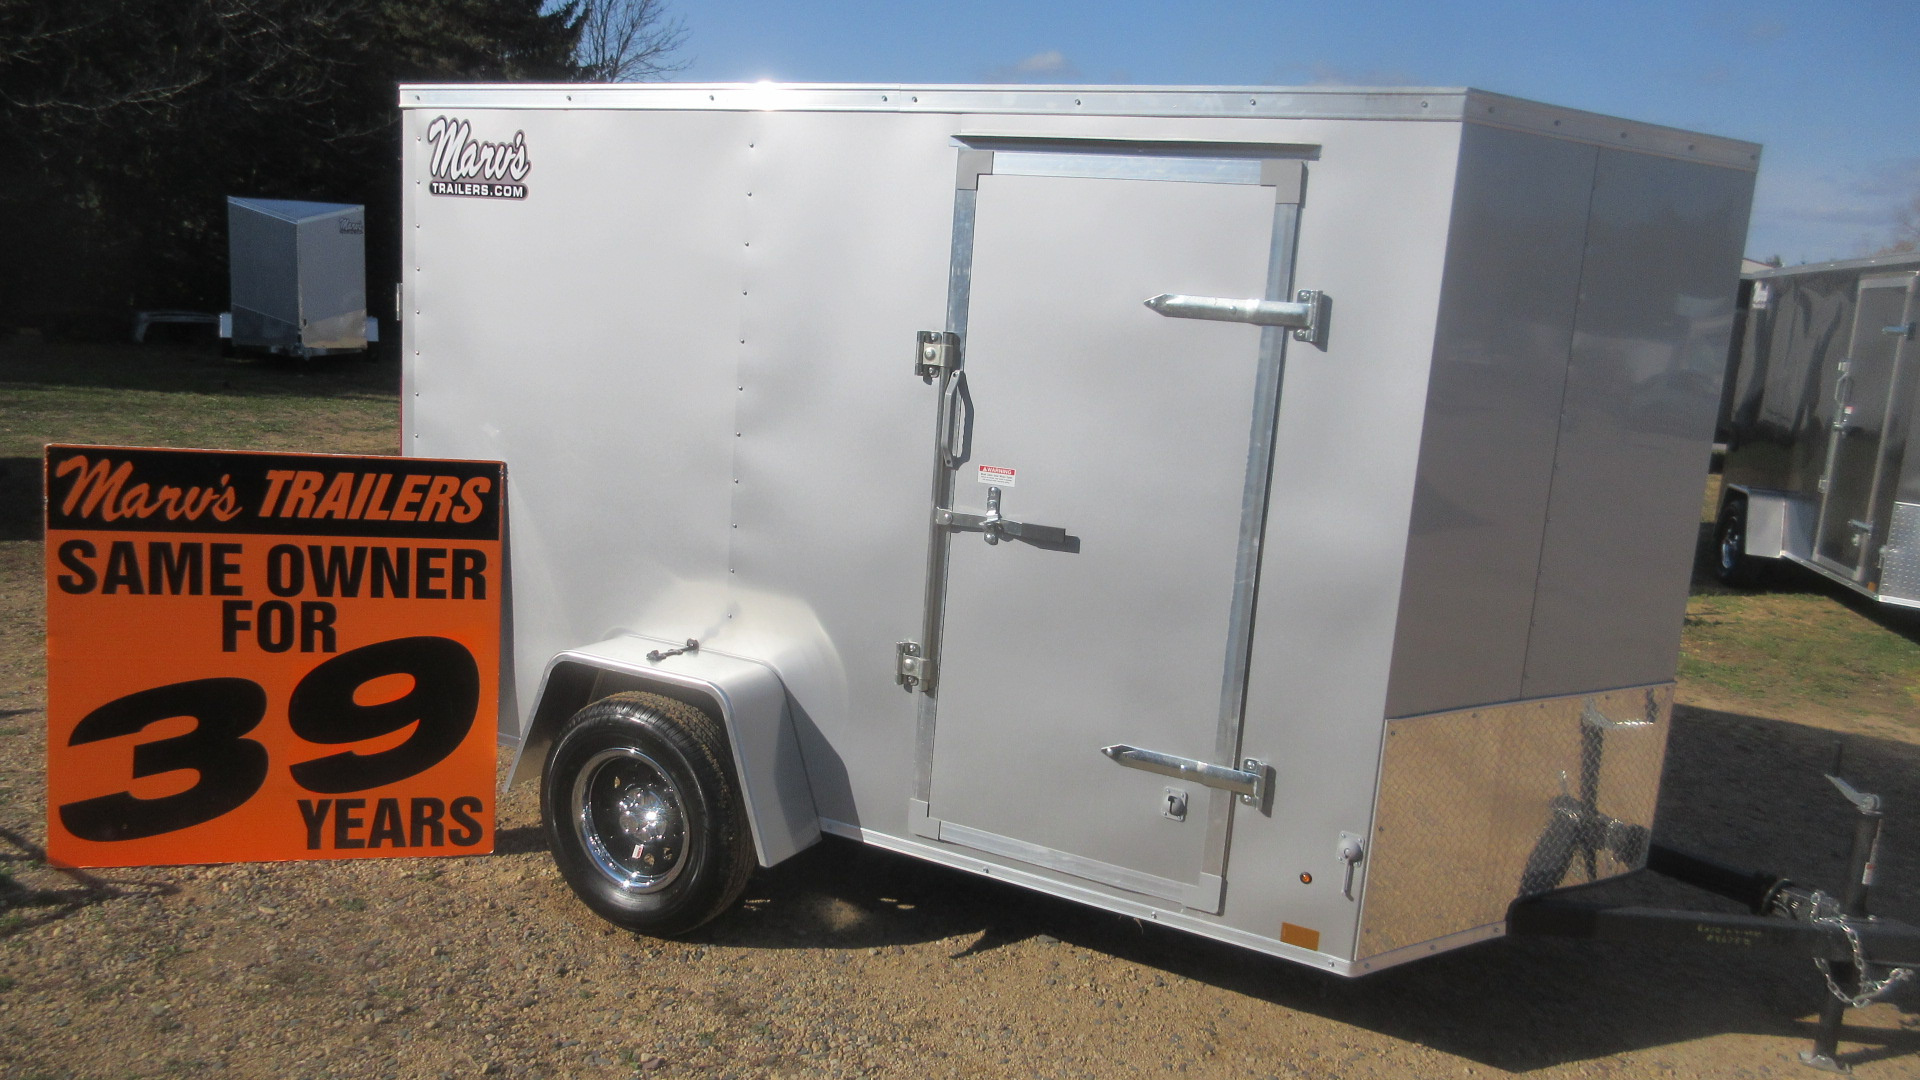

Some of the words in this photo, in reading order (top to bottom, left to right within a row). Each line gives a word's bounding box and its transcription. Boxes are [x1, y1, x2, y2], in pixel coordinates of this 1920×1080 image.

[428, 115, 531, 181] Marv's
[432, 183, 523, 197] TRAILERS.COM
[55, 455, 243, 523] Marv's
[258, 469, 491, 524] TRAILERS
[57, 539, 243, 595] SAME
[266, 543, 487, 600] OWNER
[221, 600, 337, 653] FOR
[58, 635, 480, 842] 39
[297, 796, 484, 850] YEARS
